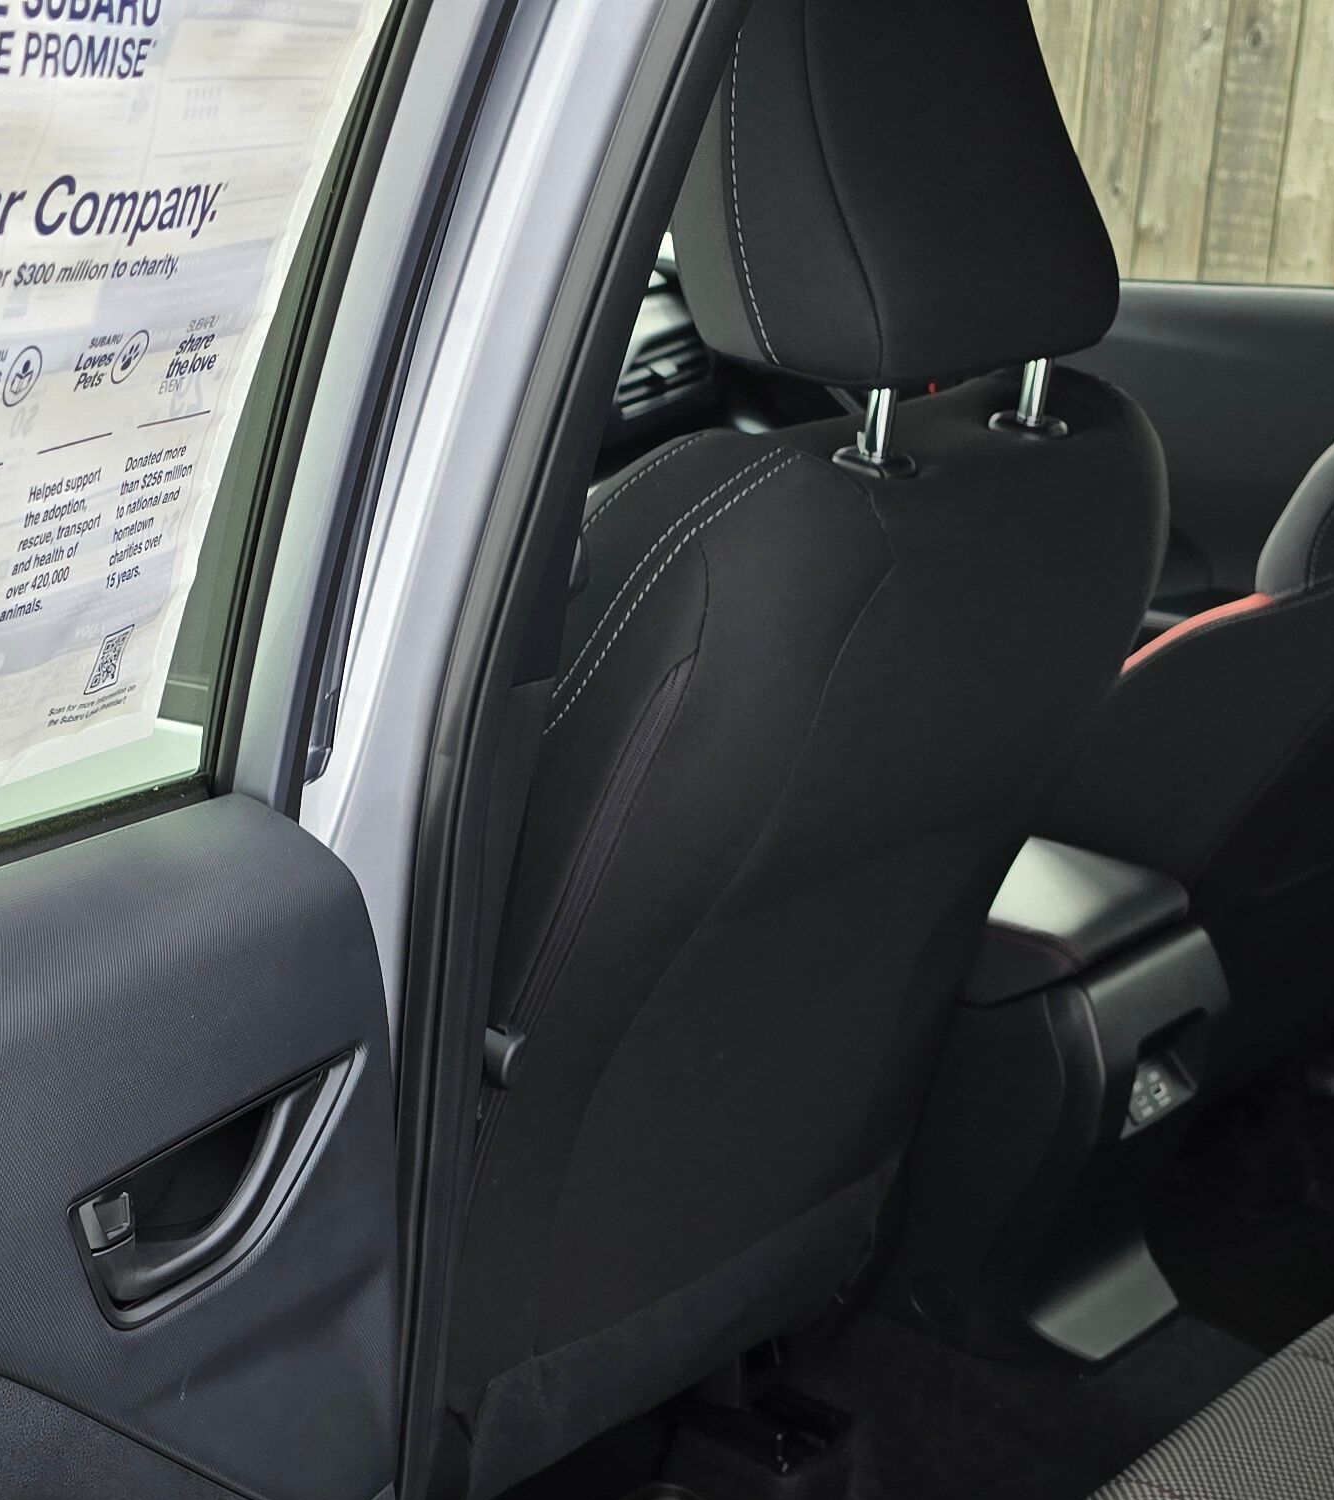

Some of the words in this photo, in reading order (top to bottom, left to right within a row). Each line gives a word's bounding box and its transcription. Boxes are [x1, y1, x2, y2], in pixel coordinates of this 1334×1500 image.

[20, 31, 152, 79] PROMISE
[14, 261, 55, 289] $300
[56, 258, 109, 284] million
[111, 258, 128, 279] to
[129, 253, 179, 280] charity.
[88, 332, 124, 350] SUBARU
[178, 332, 216, 356] share
[73, 350, 115, 374] Loves
[72, 371, 104, 393] Pets
[158, 376, 186, 396] EVENT
[124, 448, 162, 474] Donated
[162, 444, 188, 463] more
[27, 480, 65, 505] Helped
[65, 468, 102, 499] support
[120, 477, 140, 496] than
[163, 462, 193, 485] million
[23, 509, 42, 529] the
[41, 498, 88, 524] adoption,
[115, 504, 127, 521] to
[127, 495, 162, 517] national
[161, 486, 182, 508] and
[17, 533, 55, 554] rescue,
[55, 513, 102, 541] transport
[112, 515, 155, 546] hometown
[11, 556, 33, 577] and
[33, 547, 65, 573] health
[66, 541, 80, 559] of
[108, 541, 142, 568] charities
[141, 533, 164, 553] over
[5, 581, 30, 600] over
[30, 566, 71, 590] 420,000
[105, 572, 117, 591] 15
[116, 563, 140, 589] years.
